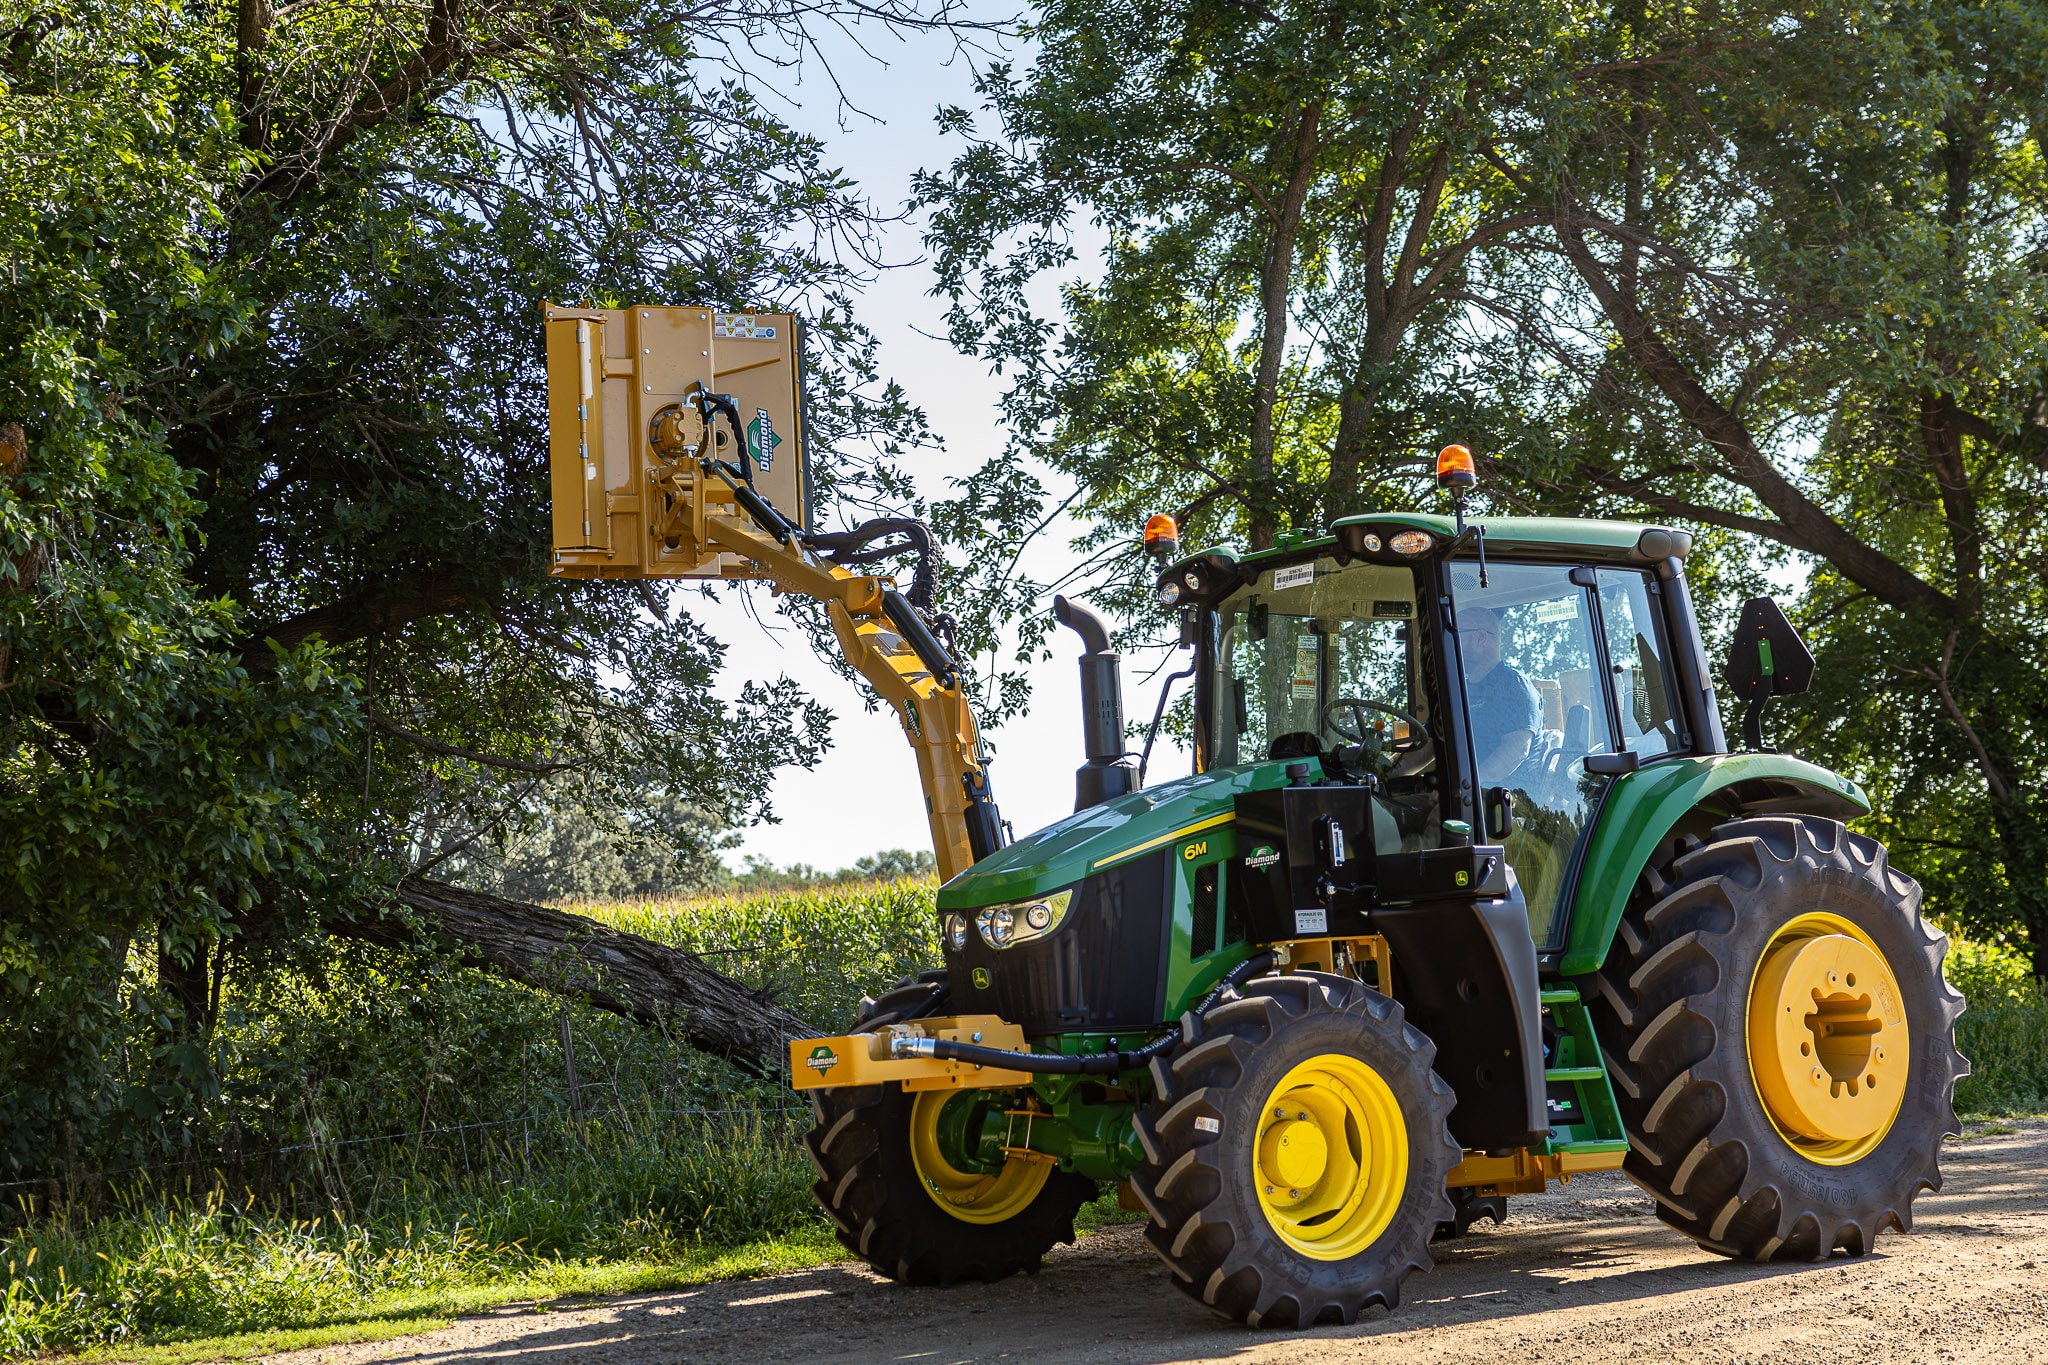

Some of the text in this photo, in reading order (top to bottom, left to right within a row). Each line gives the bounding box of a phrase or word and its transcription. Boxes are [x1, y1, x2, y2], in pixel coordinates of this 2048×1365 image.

[757, 409, 770, 471] Diamond
[1184, 841, 1208, 860] 6M
[1245, 852, 1280, 866] Diamond
[807, 1056, 838, 1067] Diamond
